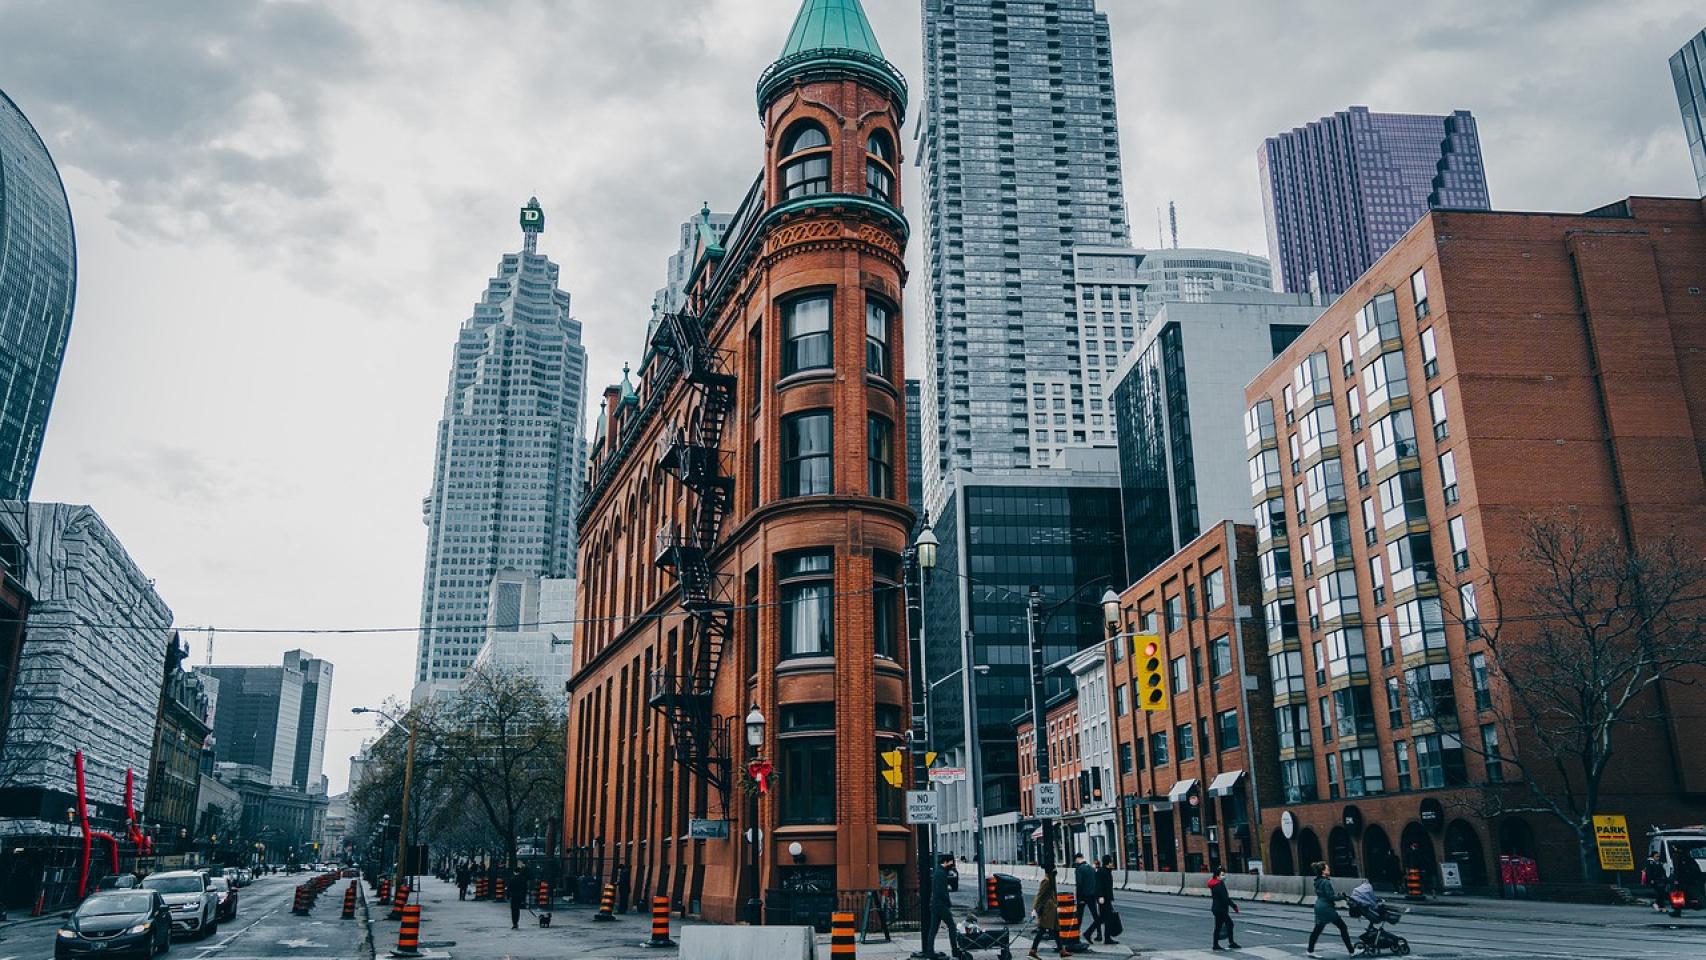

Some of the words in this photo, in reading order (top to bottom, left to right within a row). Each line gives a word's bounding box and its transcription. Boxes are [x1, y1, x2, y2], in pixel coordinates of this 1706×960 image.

[522, 210, 539, 221] TD
[1040, 785, 1054, 794] ONE
[916, 793, 929, 804] NO
[1041, 796, 1054, 805] WAY
[1036, 806, 1060, 816] BEGINS
[1596, 825, 1626, 834] PARK
